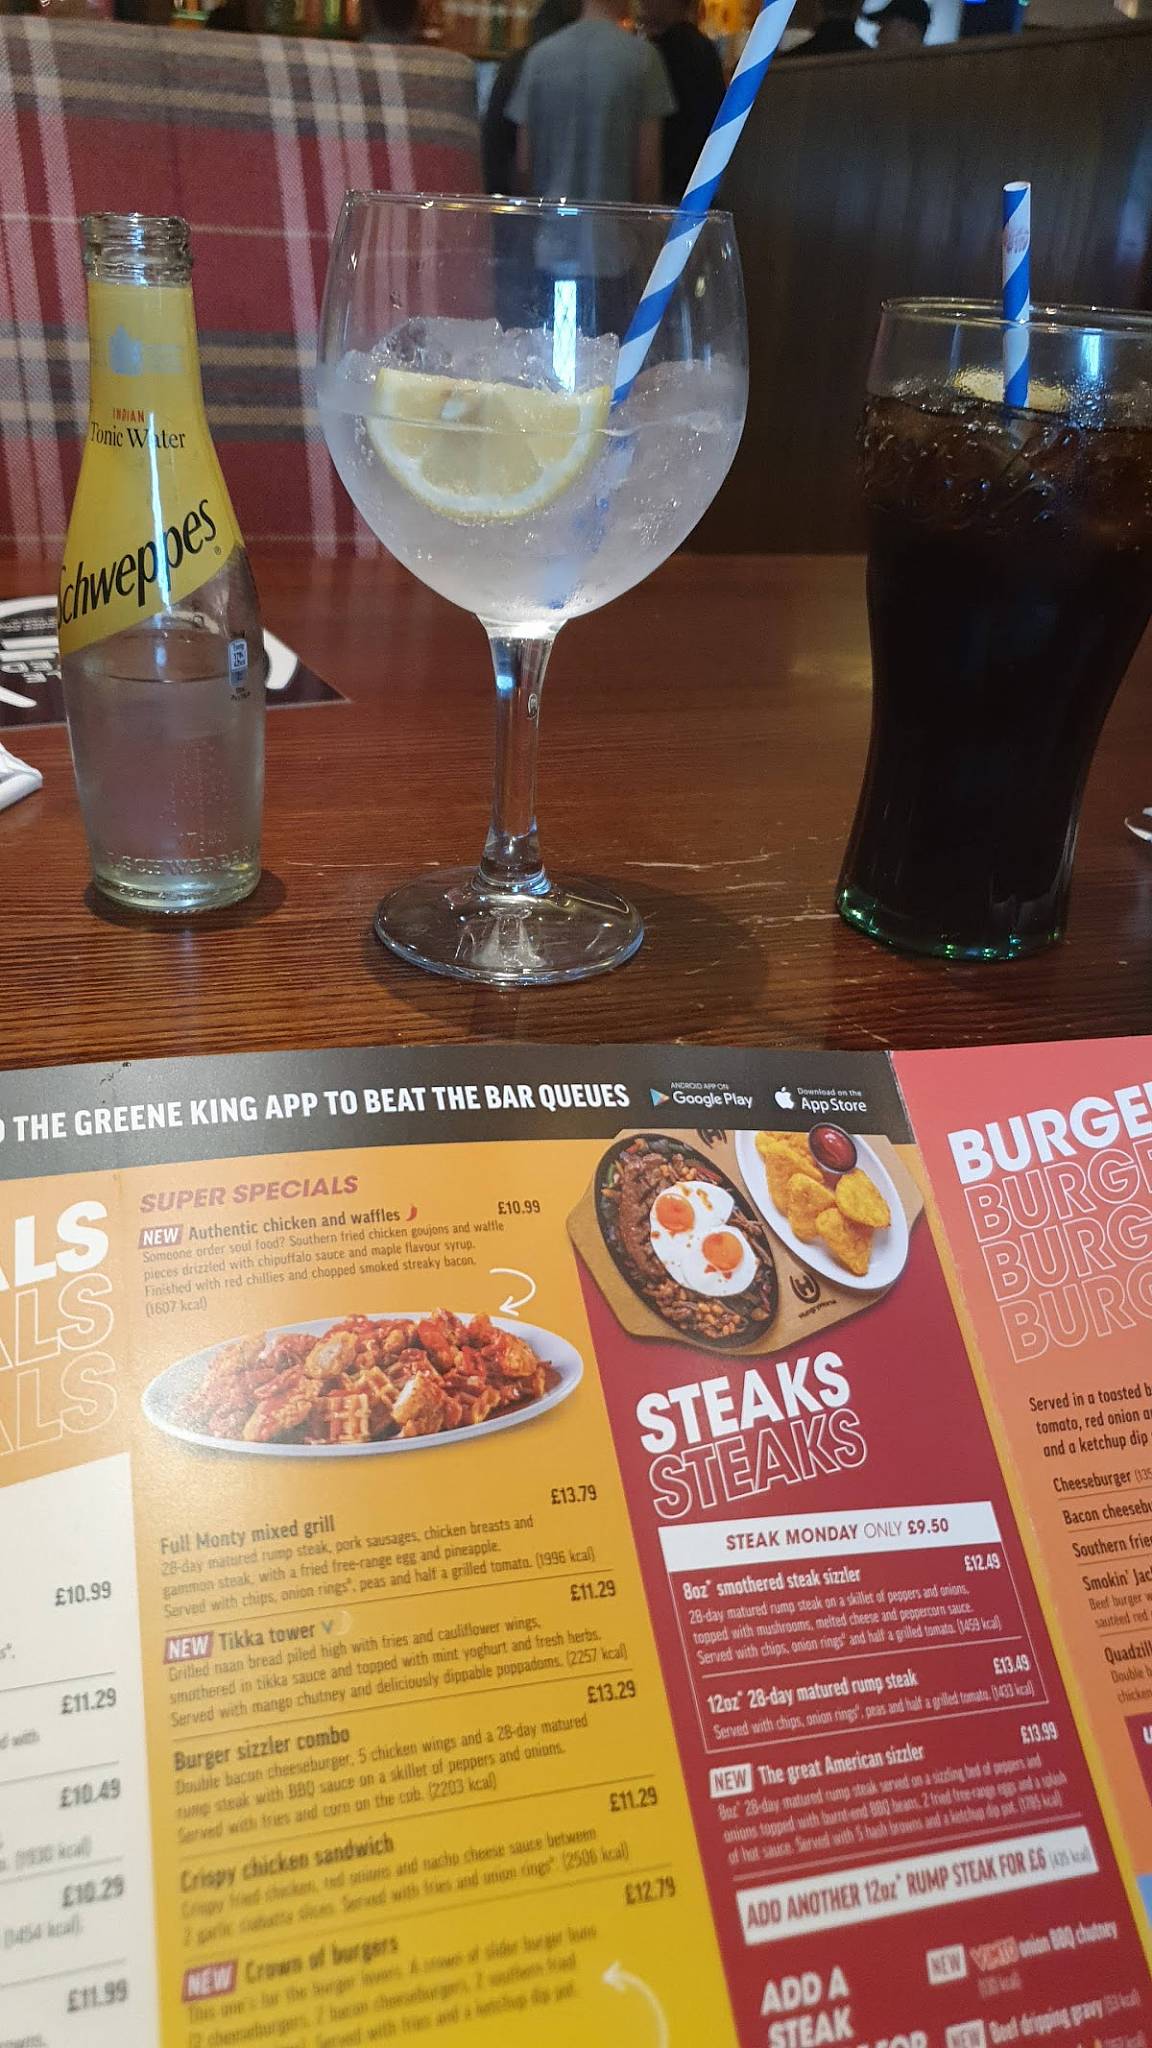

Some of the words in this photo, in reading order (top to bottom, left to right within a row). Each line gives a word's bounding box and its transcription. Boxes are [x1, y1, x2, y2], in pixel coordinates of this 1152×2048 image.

[113, 408, 145, 422] INDIAN
[91, 421, 123, 447] Tonic
[673, 1092, 723, 1109] Google
[724, 1093, 753, 1109] Play
[797, 1087, 837, 1098] Download
[838, 1090, 848, 1098] on
[849, 1089, 862, 1098] the
[801, 1098, 829, 1114] App
[830, 1099, 868, 1112] Store
[13, 1112, 67, 1142] THE
[74, 1101, 183, 1136] GREENE
[190, 1096, 257, 1126] KING
[265, 1091, 318, 1120] APP
[324, 1090, 358, 1115] TO
[365, 1087, 429, 1113] BEAT
[432, 1085, 481, 1110] THE
[485, 1084, 537, 1109] BAR
[539, 1083, 630, 1112] QUEUES
[140, 1187, 226, 1214] SUPER
[232, 1175, 359, 1205] SPECIALS
[143, 1227, 179, 1247] NEW
[188, 1220, 258, 1240] Authentic
[262, 1215, 317, 1233] chicken
[320, 1211, 346, 1227] and
[349, 1208, 400, 1224] waffles
[498, 1199, 541, 1216] £10.99
[0, 1200, 110, 1291] LS
[141, 1248, 192, 1263] Someone
[228, 1238, 252, 1253] soul
[254, 1235, 285, 1250] food?
[288, 1232, 338, 1247] Southern
[339, 1228, 365, 1242] fried
[367, 1226, 408, 1240] chicken
[410, 1225, 449, 1239] goujons
[451, 1221, 471, 1234] and
[472, 1219, 504, 1232] waffle
[143, 1266, 179, 1282] pieces
[181, 1258, 226, 1275] drizzled
[228, 1255, 255, 1270] with
[314, 1250, 345, 1262] sauce
[347, 1245, 368, 1258] and
[370, 1243, 402, 1257] maple
[404, 1241, 440, 1253] flavour
[143, 1280, 192, 1297] Finished
[194, 1277, 221, 1291] with
[223, 1274, 243, 1288] red
[245, 1270, 285, 1286] chillies
[287, 1268, 308, 1281] and
[310, 1263, 356, 1279] chopped
[358, 1260, 399, 1274] smoked
[401, 1257, 441, 1270] streaky
[443, 1255, 476, 1267] bacon.
[0, 1273, 115, 1371] LS
[0, 1351, 118, 1455] LS
[636, 1351, 851, 1453] STEAKS
[1028, 1392, 1070, 1412] Served
[1071, 1391, 1085, 1407] in
[1086, 1393, 1095, 1405] a
[1097, 1384, 1142, 1403] toasted
[1035, 1417, 1082, 1434] tomato,
[1083, 1411, 1105, 1427] red
[1106, 1408, 1140, 1424] onion
[1042, 1440, 1066, 1457] and
[1067, 1441, 1077, 1454] a
[1077, 1433, 1126, 1452] ketchup
[1128, 1429, 1149, 1447] dip
[649, 1408, 868, 1519] STEAKS
[551, 1484, 597, 1505] £13.79
[1052, 1471, 1131, 1492] Cheeseburger
[725, 1530, 779, 1550] STEAK
[785, 1524, 857, 1544] MONDAY
[863, 1520, 902, 1539] ONLY
[906, 1517, 949, 1535] £9.50
[1061, 1509, 1100, 1525] Bacon
[159, 1534, 190, 1555] Full
[195, 1530, 246, 1550] Monty
[250, 1519, 298, 1542] mixed
[303, 1514, 335, 1539] grill
[1071, 1538, 1127, 1558] Southern
[716, 1572, 785, 1595] smothered
[785, 1568, 821, 1586] steak
[822, 1565, 860, 1583] sizzler
[963, 1552, 1001, 1572] £12.49
[1081, 1569, 1128, 1591] Smokin'
[55, 1580, 113, 1606] £10.99
[570, 1579, 616, 1602] £11.29
[167, 1635, 209, 1659] NEW
[220, 1630, 264, 1651] Tikka
[268, 1624, 315, 1644] tower
[587, 1680, 636, 1704] £13.29
[746, 1686, 793, 1708] 28-day
[795, 1676, 849, 1701] matured
[850, 1676, 884, 1694] rump
[884, 1668, 918, 1689] steak
[993, 1654, 1030, 1676] £13.49
[61, 1688, 117, 1715] £11.29
[173, 1747, 230, 1771] Burger
[236, 1736, 290, 1759] sizzler
[296, 1727, 350, 1750] combo
[1020, 1721, 1058, 1745] £13.99
[713, 1767, 747, 1792] NEW
[757, 1764, 784, 1785] The
[786, 1759, 822, 1785] great
[824, 1751, 883, 1774] American
[884, 1743, 923, 1765] sizzler
[60, 1777, 121, 1808] £10.49
[609, 1786, 658, 1813] £11.29
[179, 1866, 236, 1893] Crispy
[241, 1852, 309, 1880] chicken
[314, 1834, 394, 1866] sandwich
[625, 1875, 676, 1906] £12.79
[746, 1899, 782, 1928] ADD
[786, 1883, 860, 1918] ANOTHER
[905, 1866, 949, 1894] RUMP
[951, 1857, 997, 1887] STEAK
[998, 1851, 1026, 1876] FOR
[1027, 1846, 1047, 1871] £6
[760, 1971, 822, 2016] ADD
[828, 1965, 849, 2000] A
[768, 2005, 854, 2048] STEAK
